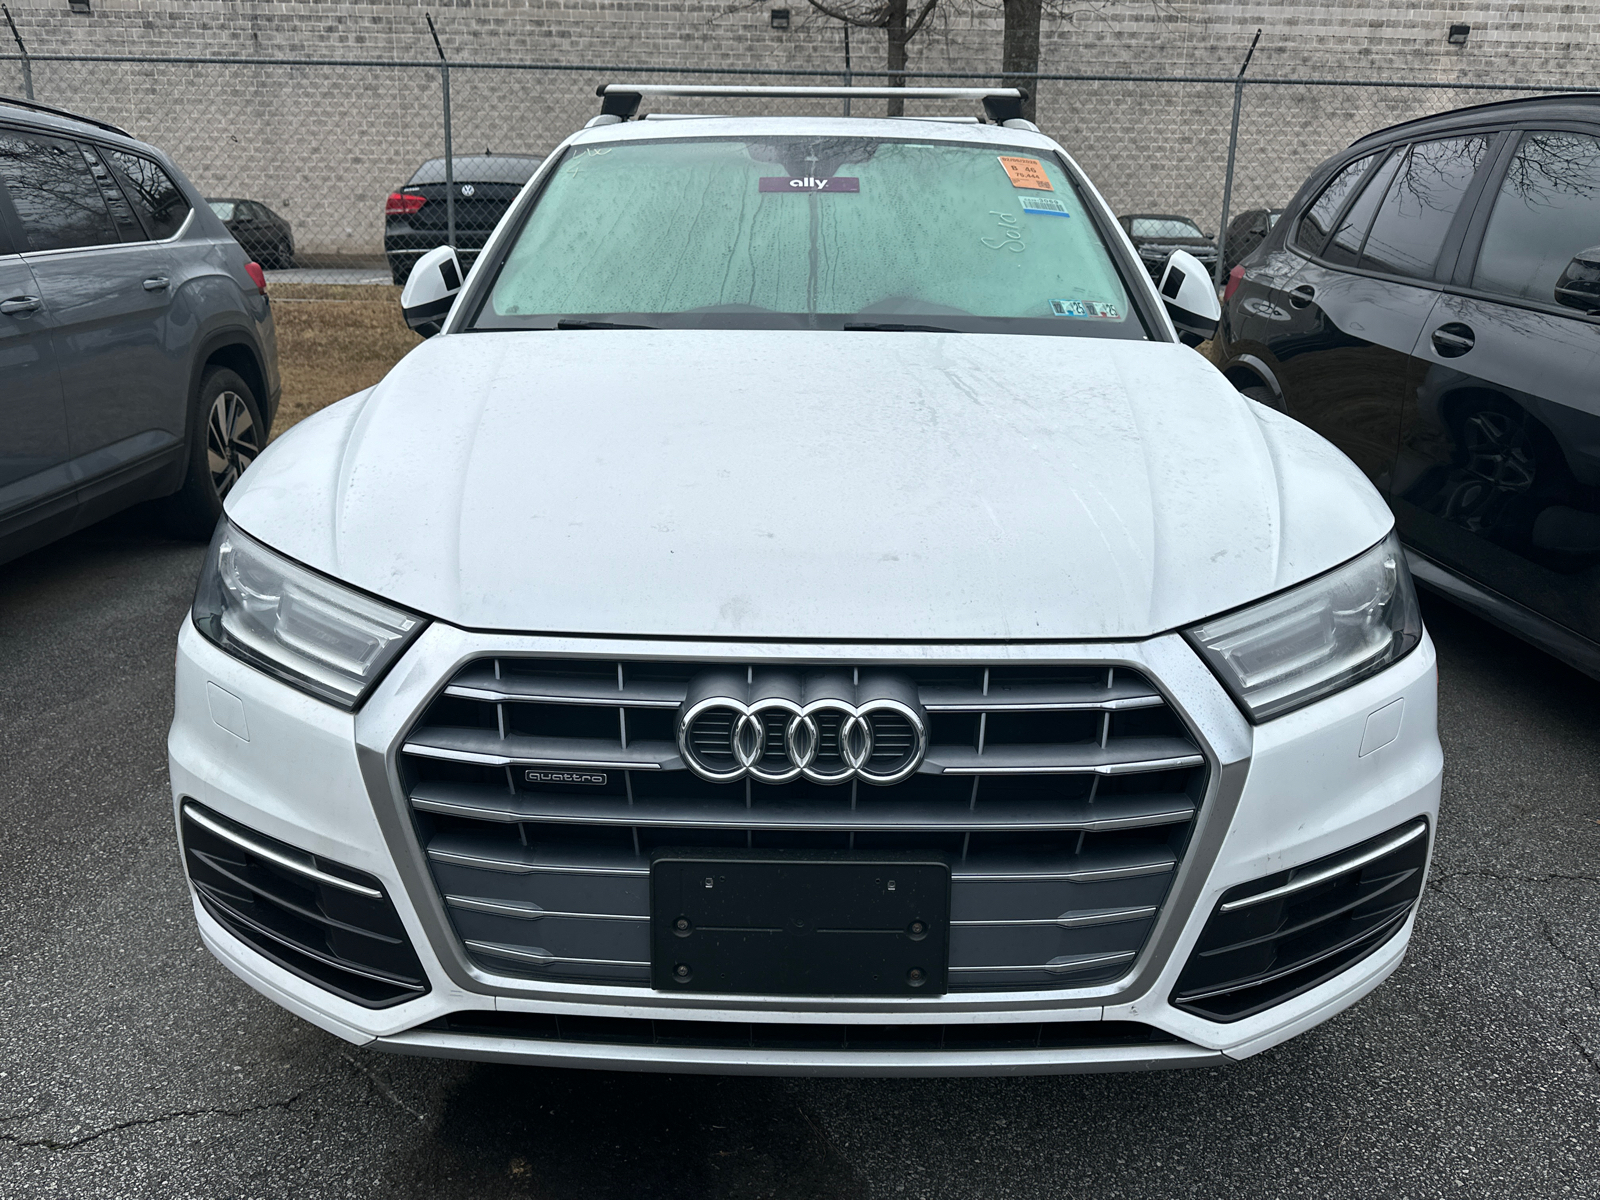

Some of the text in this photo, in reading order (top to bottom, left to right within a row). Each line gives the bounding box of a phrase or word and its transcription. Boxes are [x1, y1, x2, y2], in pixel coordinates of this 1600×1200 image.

[789, 177, 828, 190] ally
[981, 211, 1026, 252] Sold
[529, 773, 603, 783] quattro
